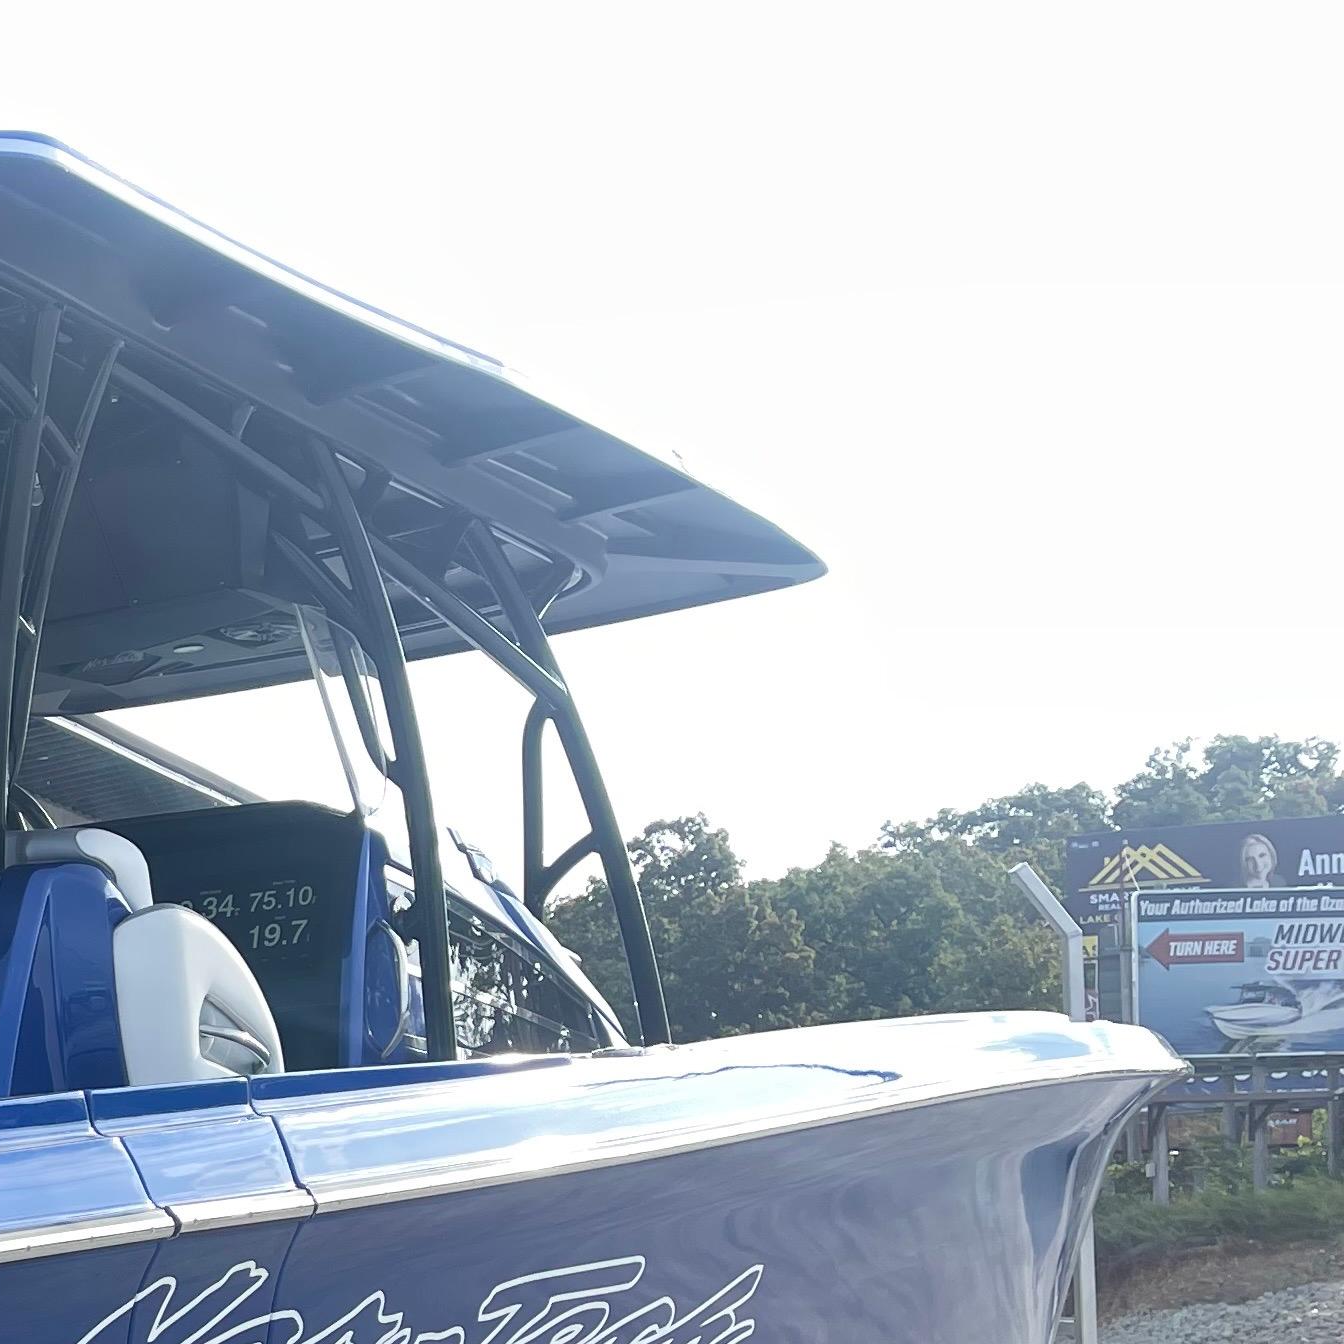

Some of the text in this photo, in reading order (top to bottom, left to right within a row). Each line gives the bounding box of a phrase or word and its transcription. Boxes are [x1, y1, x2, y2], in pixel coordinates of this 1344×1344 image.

[1139, 900, 1171, 916] Your
[1171, 898, 1244, 915] Authorized
[1245, 897, 1277, 913] Lake
[1279, 896, 1295, 912] of
[1296, 897, 1318, 911] the
[249, 919, 308, 949] 19.7
[1273, 923, 1344, 945] MIDW
[1169, 940, 1237, 956] TURN HERE
[1267, 950, 1342, 971] SUPER
